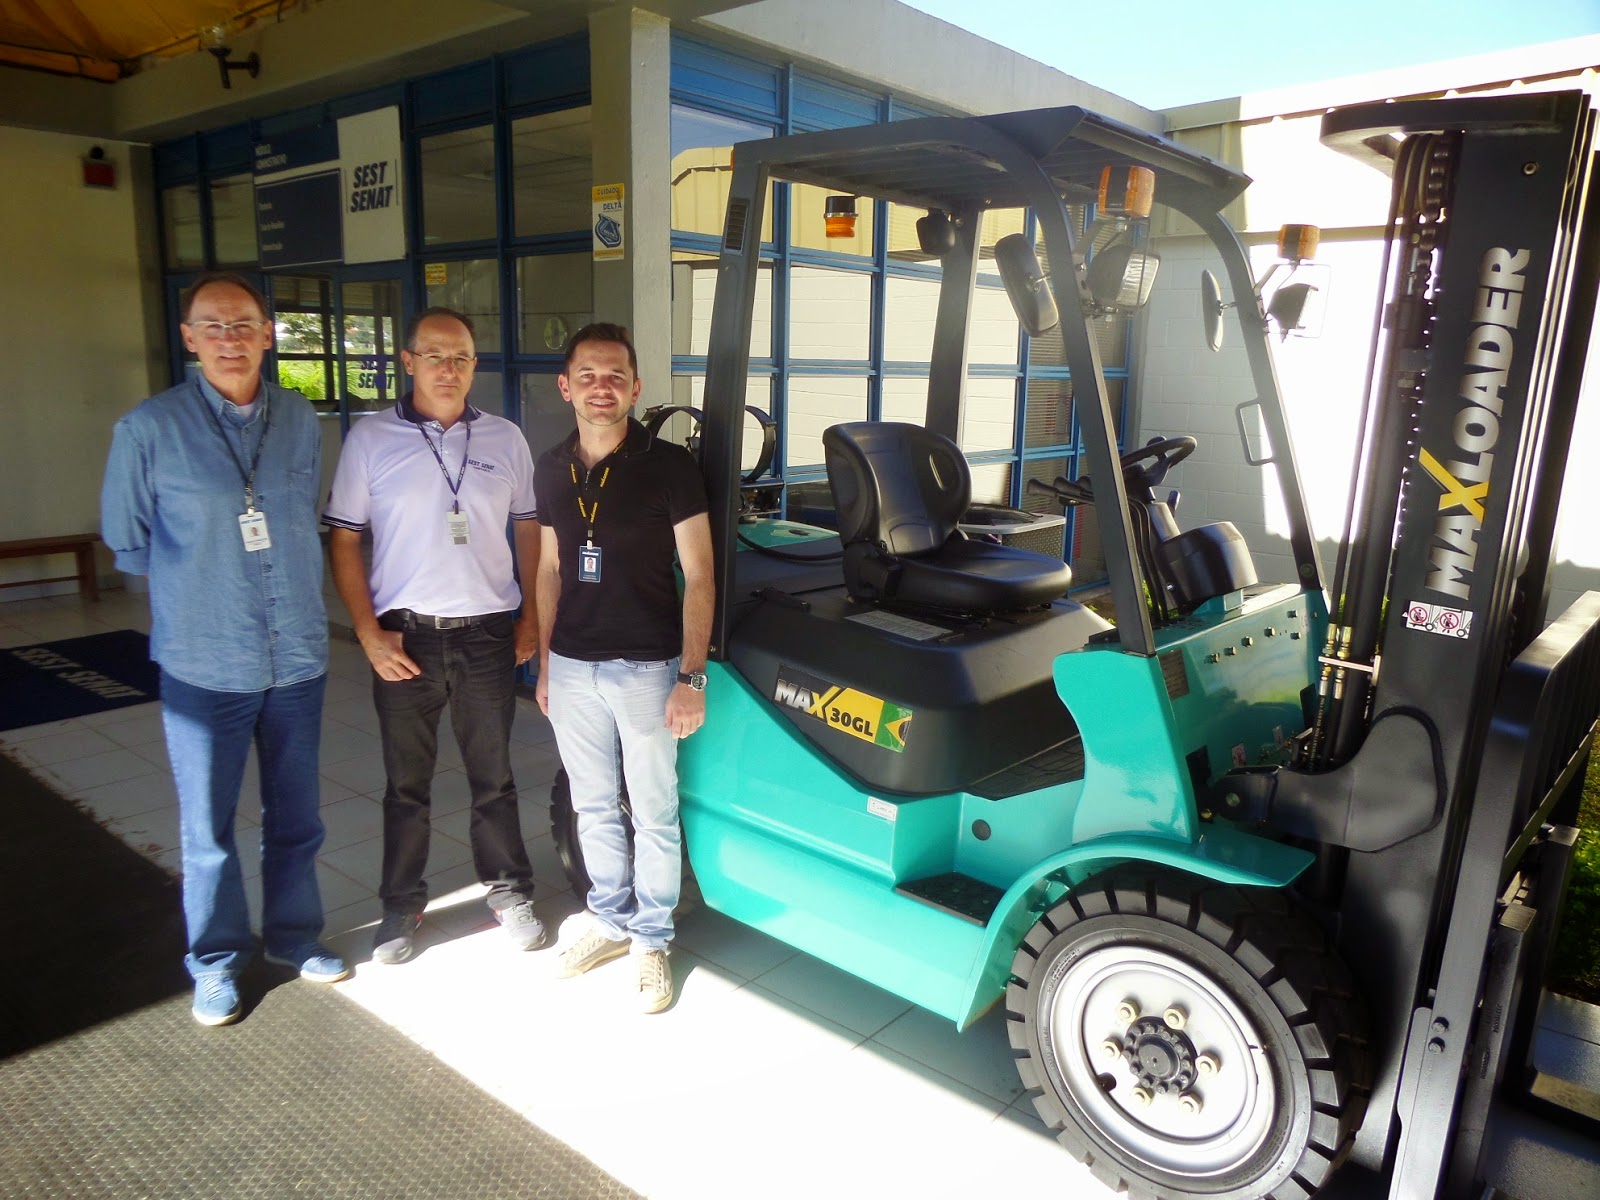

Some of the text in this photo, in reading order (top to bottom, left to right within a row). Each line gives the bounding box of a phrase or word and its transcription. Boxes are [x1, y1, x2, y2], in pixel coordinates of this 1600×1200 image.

[353, 161, 388, 188] SEST
[350, 185, 393, 213] SENAT
[603, 201, 622, 210] DELTA
[1418, 246, 1531, 600] MAXLOADER
[774, 679, 841, 719] MAX
[830, 708, 873, 736] 30GL
